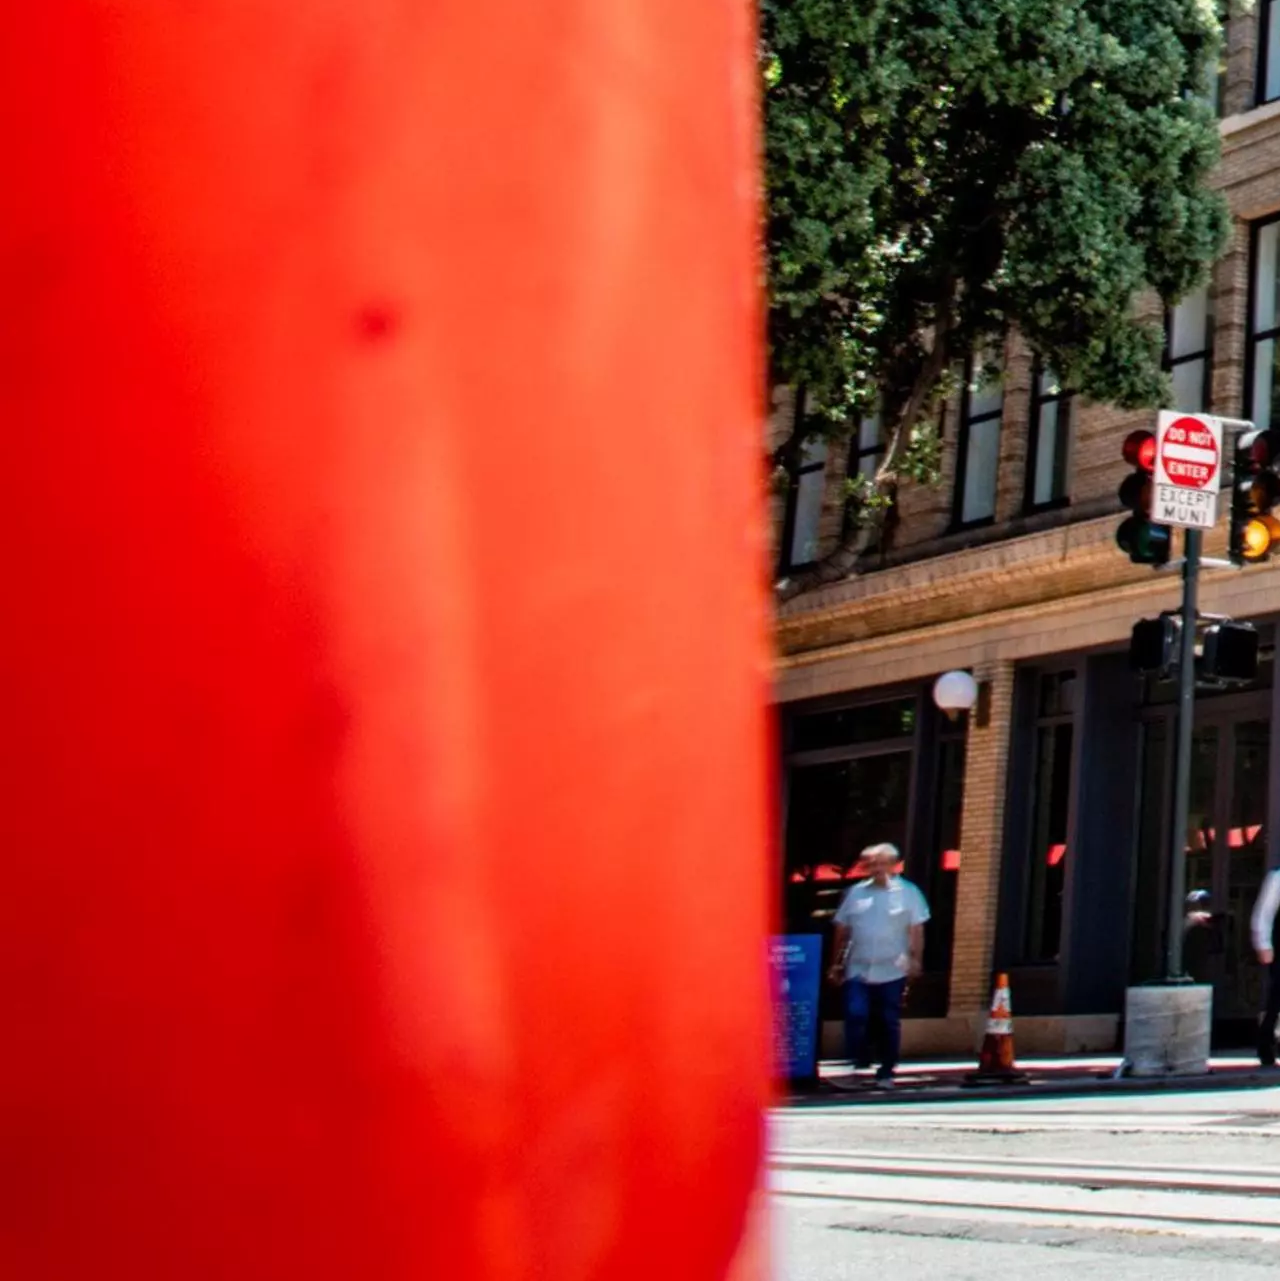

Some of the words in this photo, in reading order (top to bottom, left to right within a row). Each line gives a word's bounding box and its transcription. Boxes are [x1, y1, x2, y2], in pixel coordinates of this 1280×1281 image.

[1167, 427, 1186, 442] DO
[1189, 431, 1212, 446] NOT
[1168, 462, 1208, 478] ENTER
[1160, 488, 1211, 507] EXCEPT
[1164, 506, 1207, 524] MUNI
